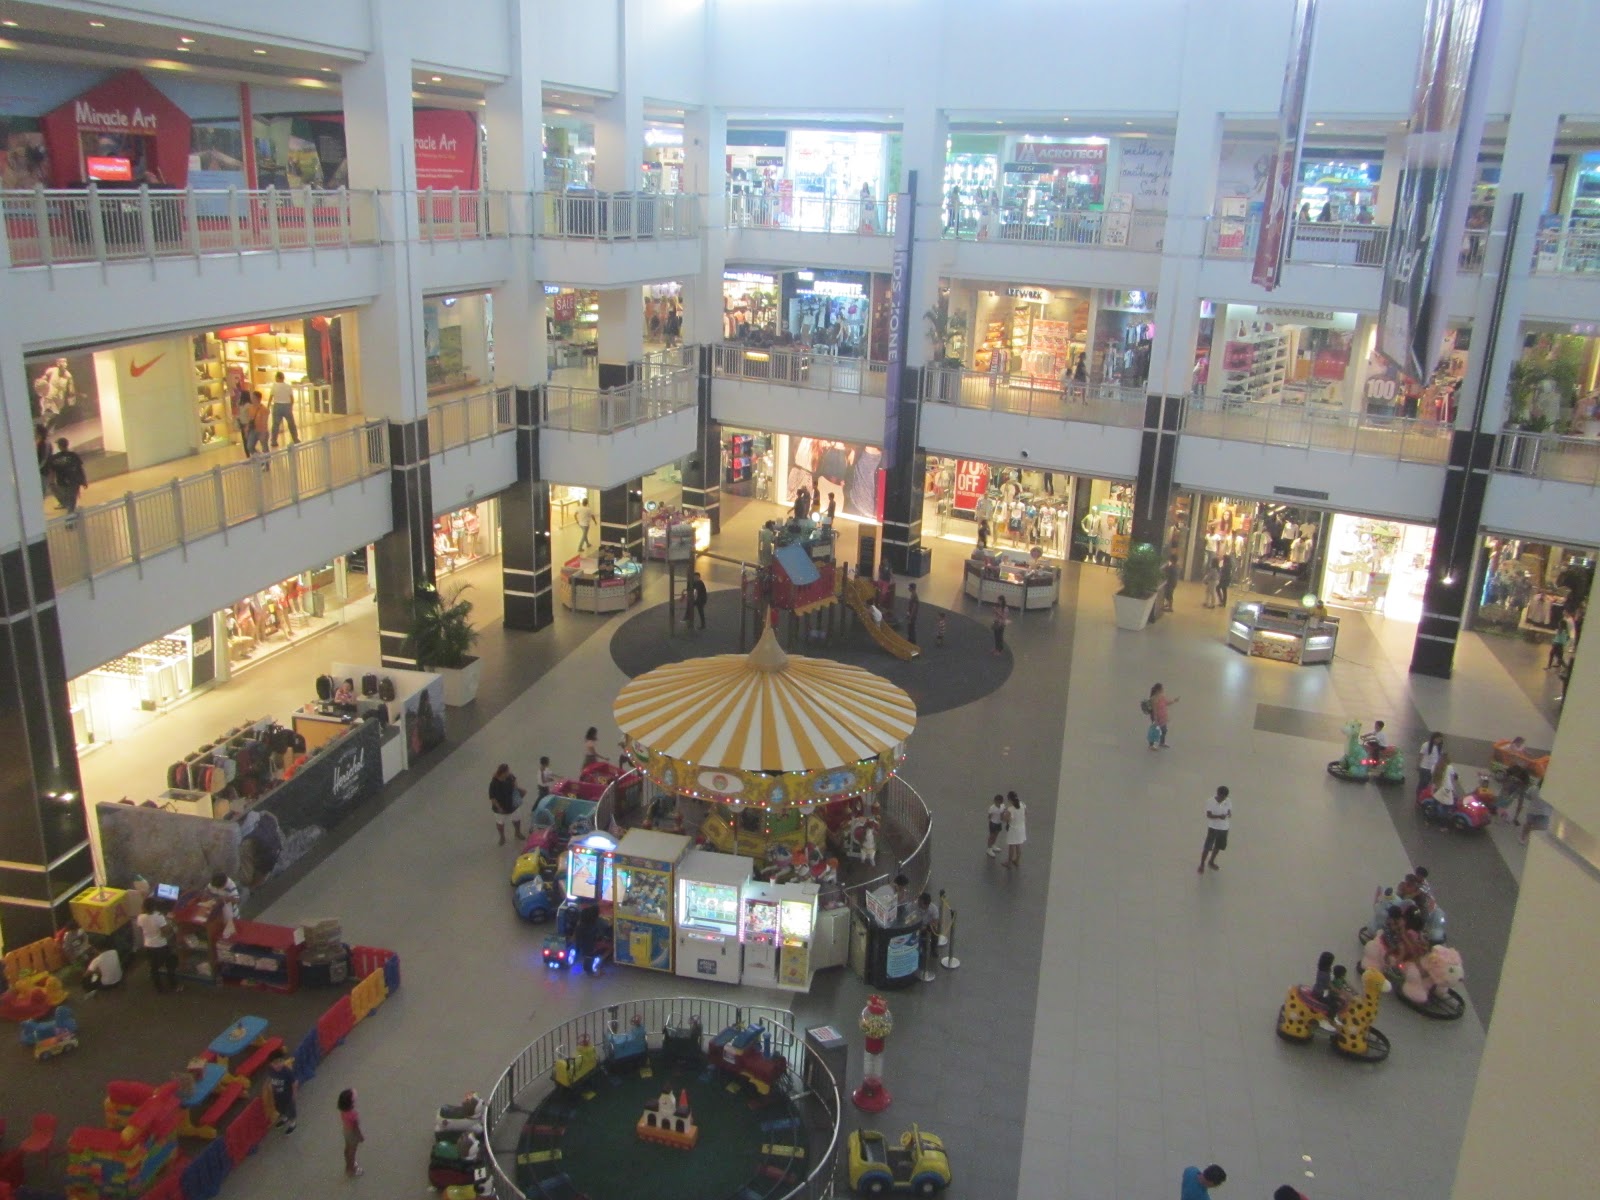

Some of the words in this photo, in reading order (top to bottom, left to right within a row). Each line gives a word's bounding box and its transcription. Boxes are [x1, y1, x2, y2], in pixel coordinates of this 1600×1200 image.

[76, 101, 129, 126] Miracle
[132, 107, 157, 128] Art
[414, 136, 437, 150] racle
[440, 133, 456, 151] Art
[556, 297, 574, 310] SALE
[1367, 379, 1396, 399] 100
[958, 473, 981, 492] OFF
